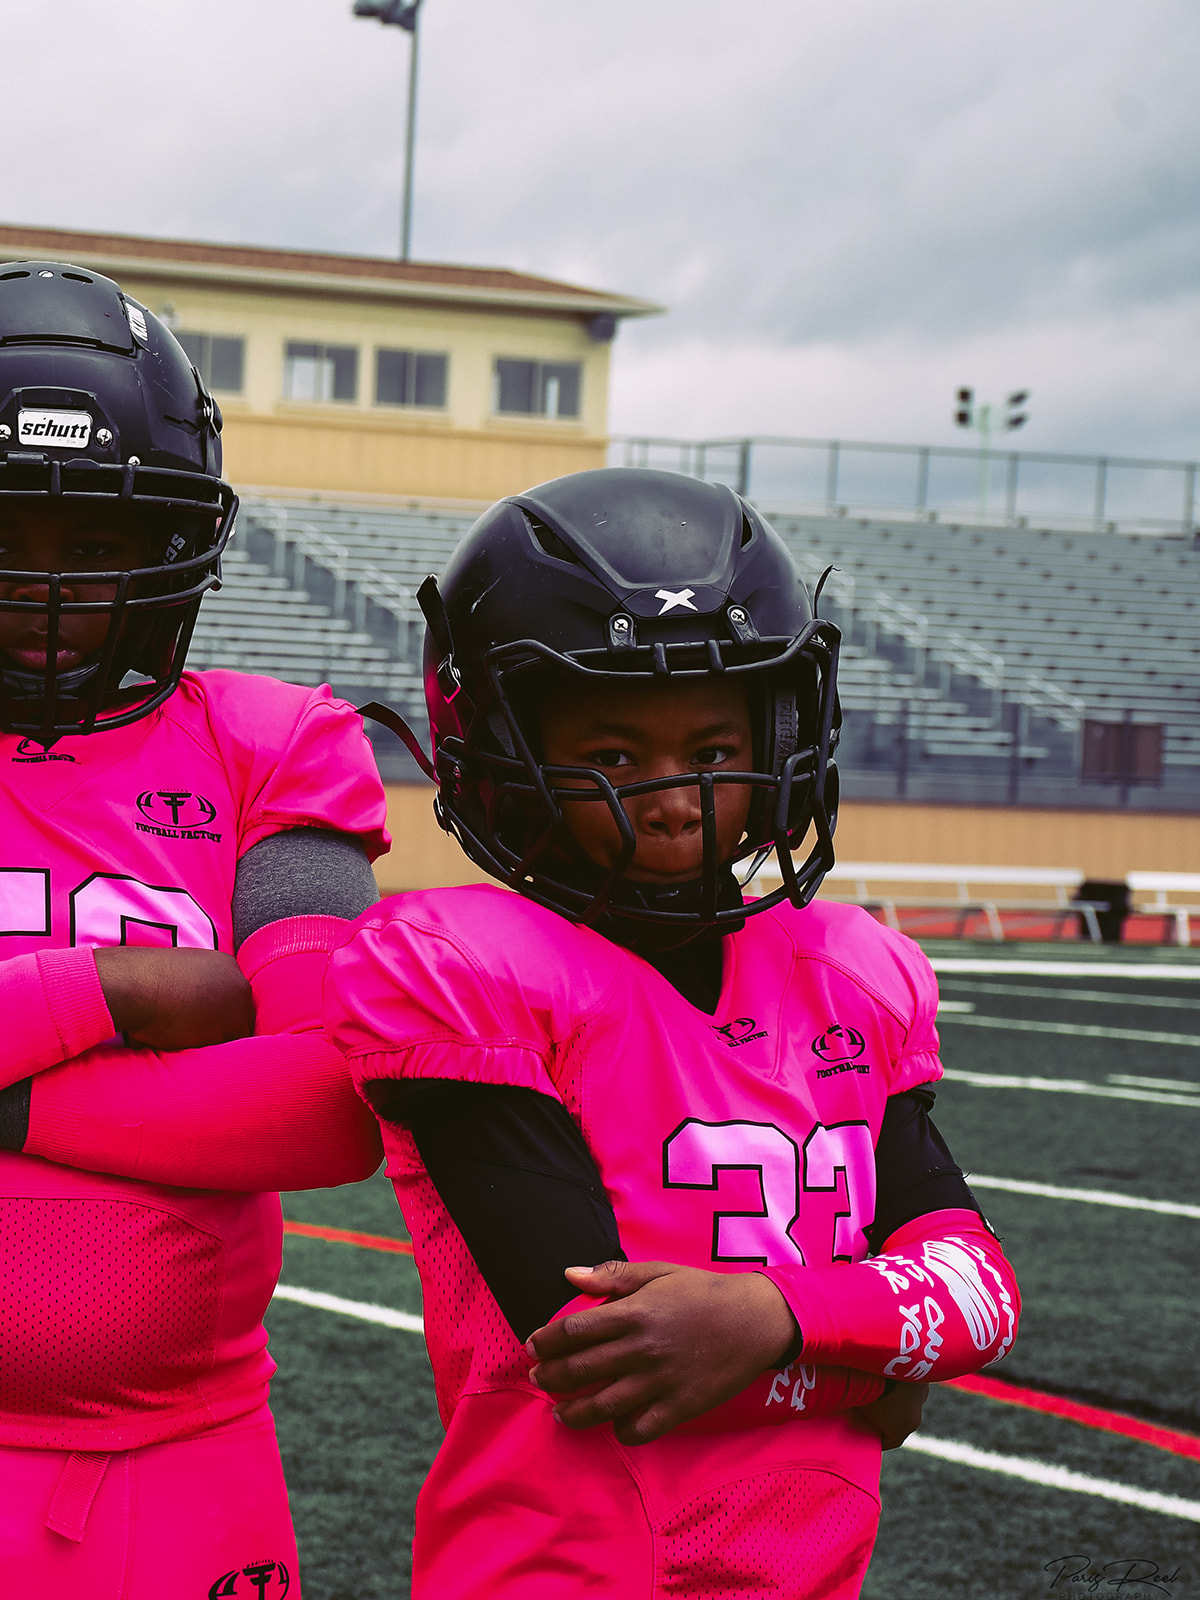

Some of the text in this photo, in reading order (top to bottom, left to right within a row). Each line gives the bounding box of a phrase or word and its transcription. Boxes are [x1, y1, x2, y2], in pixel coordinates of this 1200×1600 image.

[21, 419, 88, 439] schutt
[135, 822, 222, 844] FOOTBALL FACTORY
